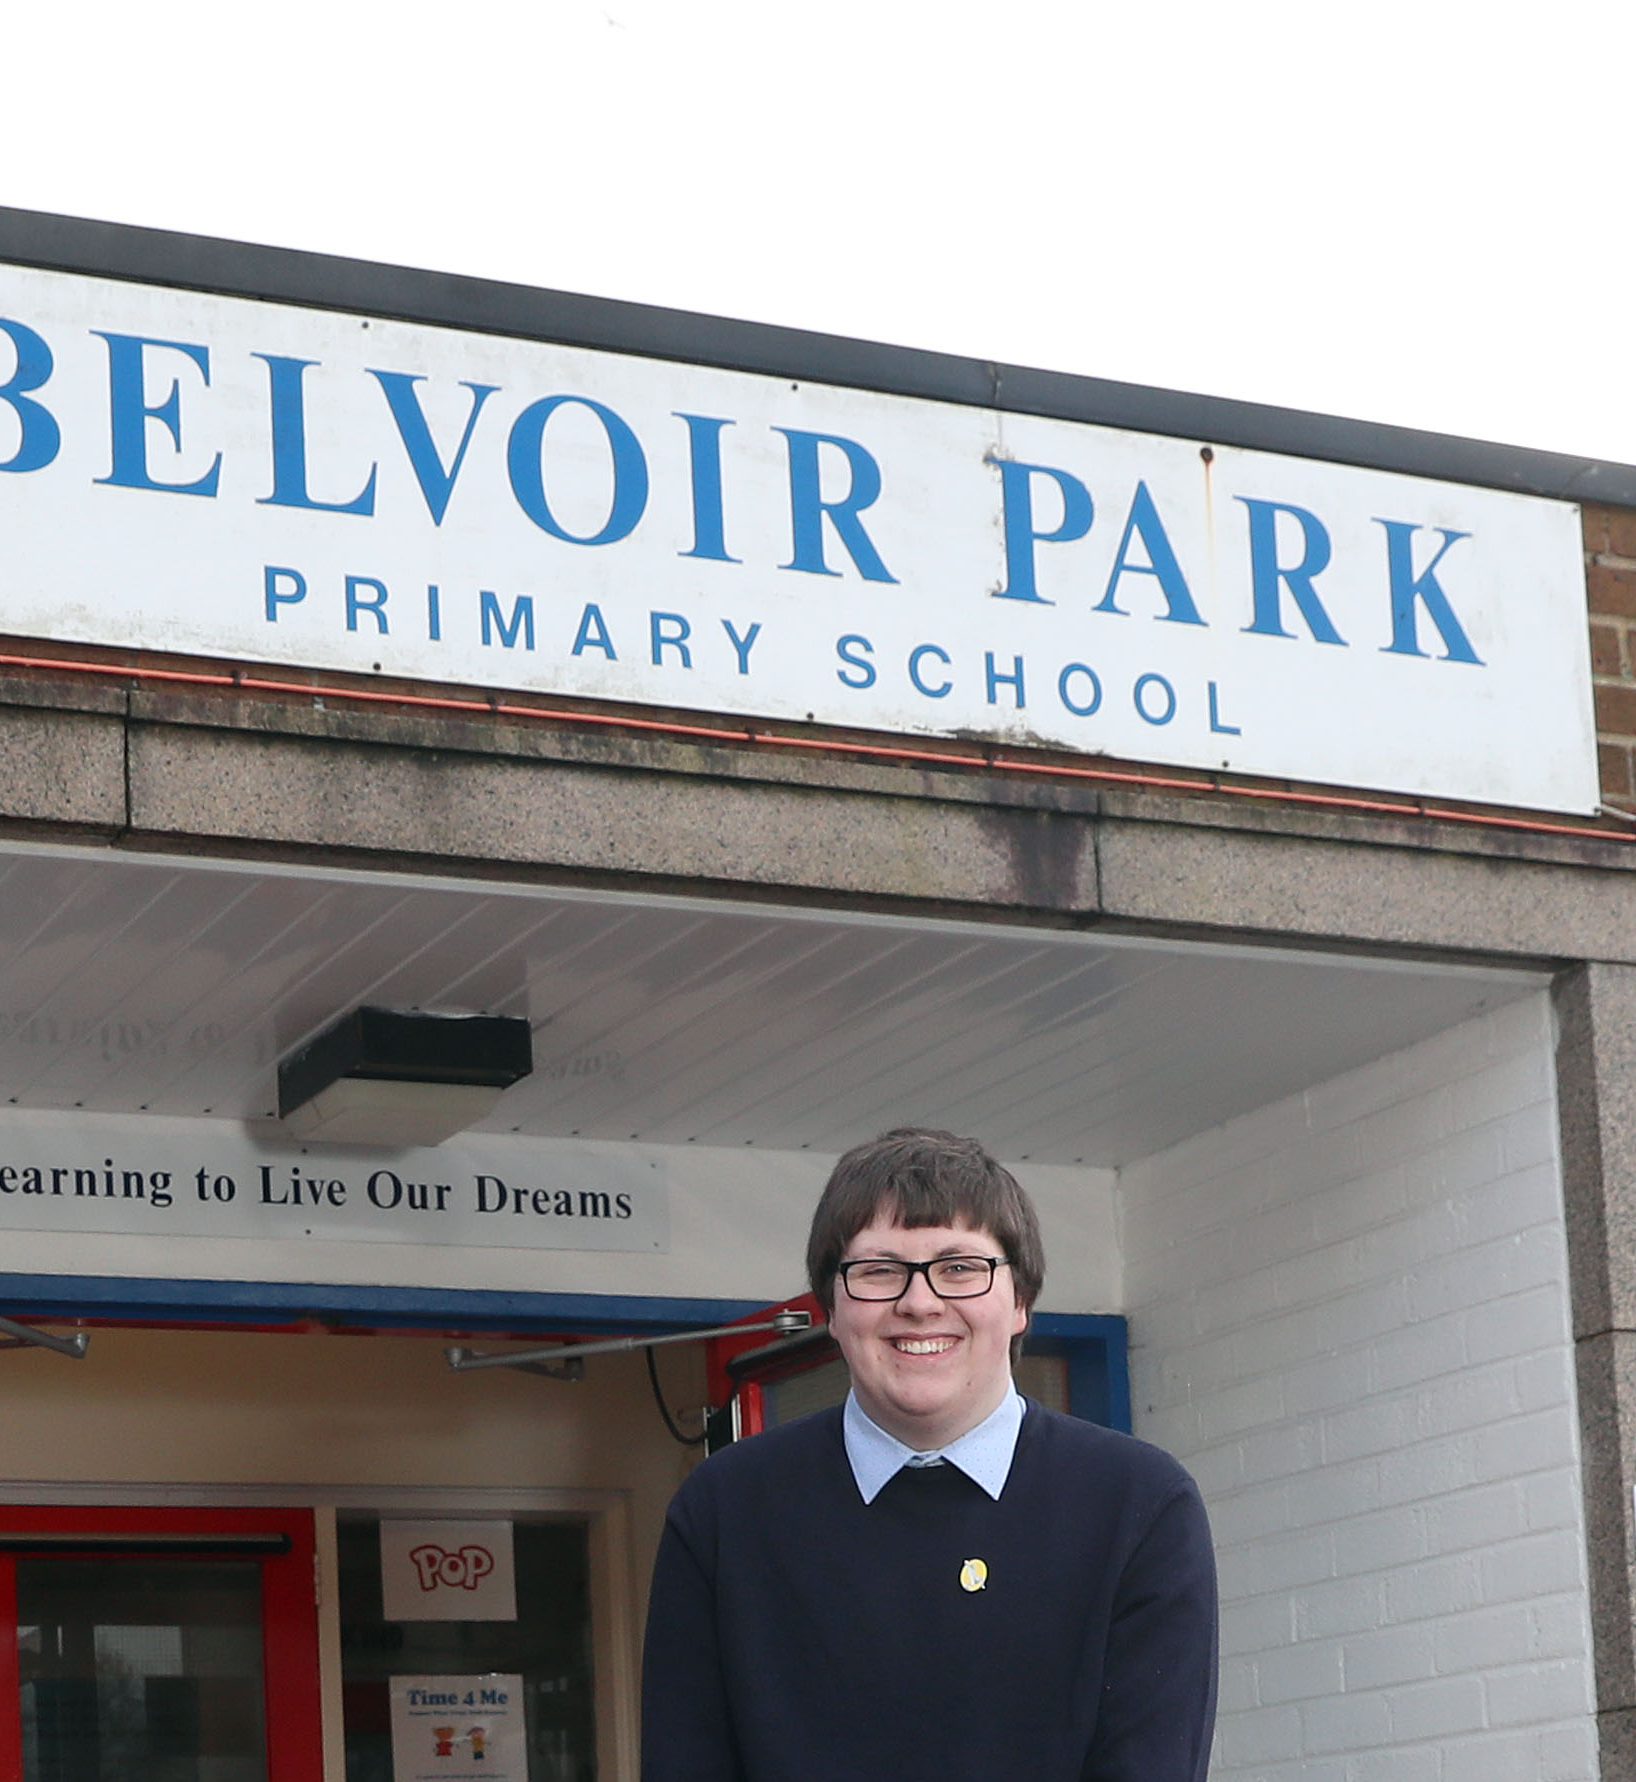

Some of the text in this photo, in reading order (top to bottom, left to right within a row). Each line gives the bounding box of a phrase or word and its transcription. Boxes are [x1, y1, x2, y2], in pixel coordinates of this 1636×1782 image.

[986, 456, 1485, 666] PARK
[265, 566, 1241, 735] PRIMARY SCHOOL
[194, 1166, 236, 1203] to
[257, 1165, 347, 1207] Live
[366, 1170, 452, 1211] Our
[474, 1175, 632, 1220] Dreams
[407, 1688, 509, 1706] Time 4 Me
